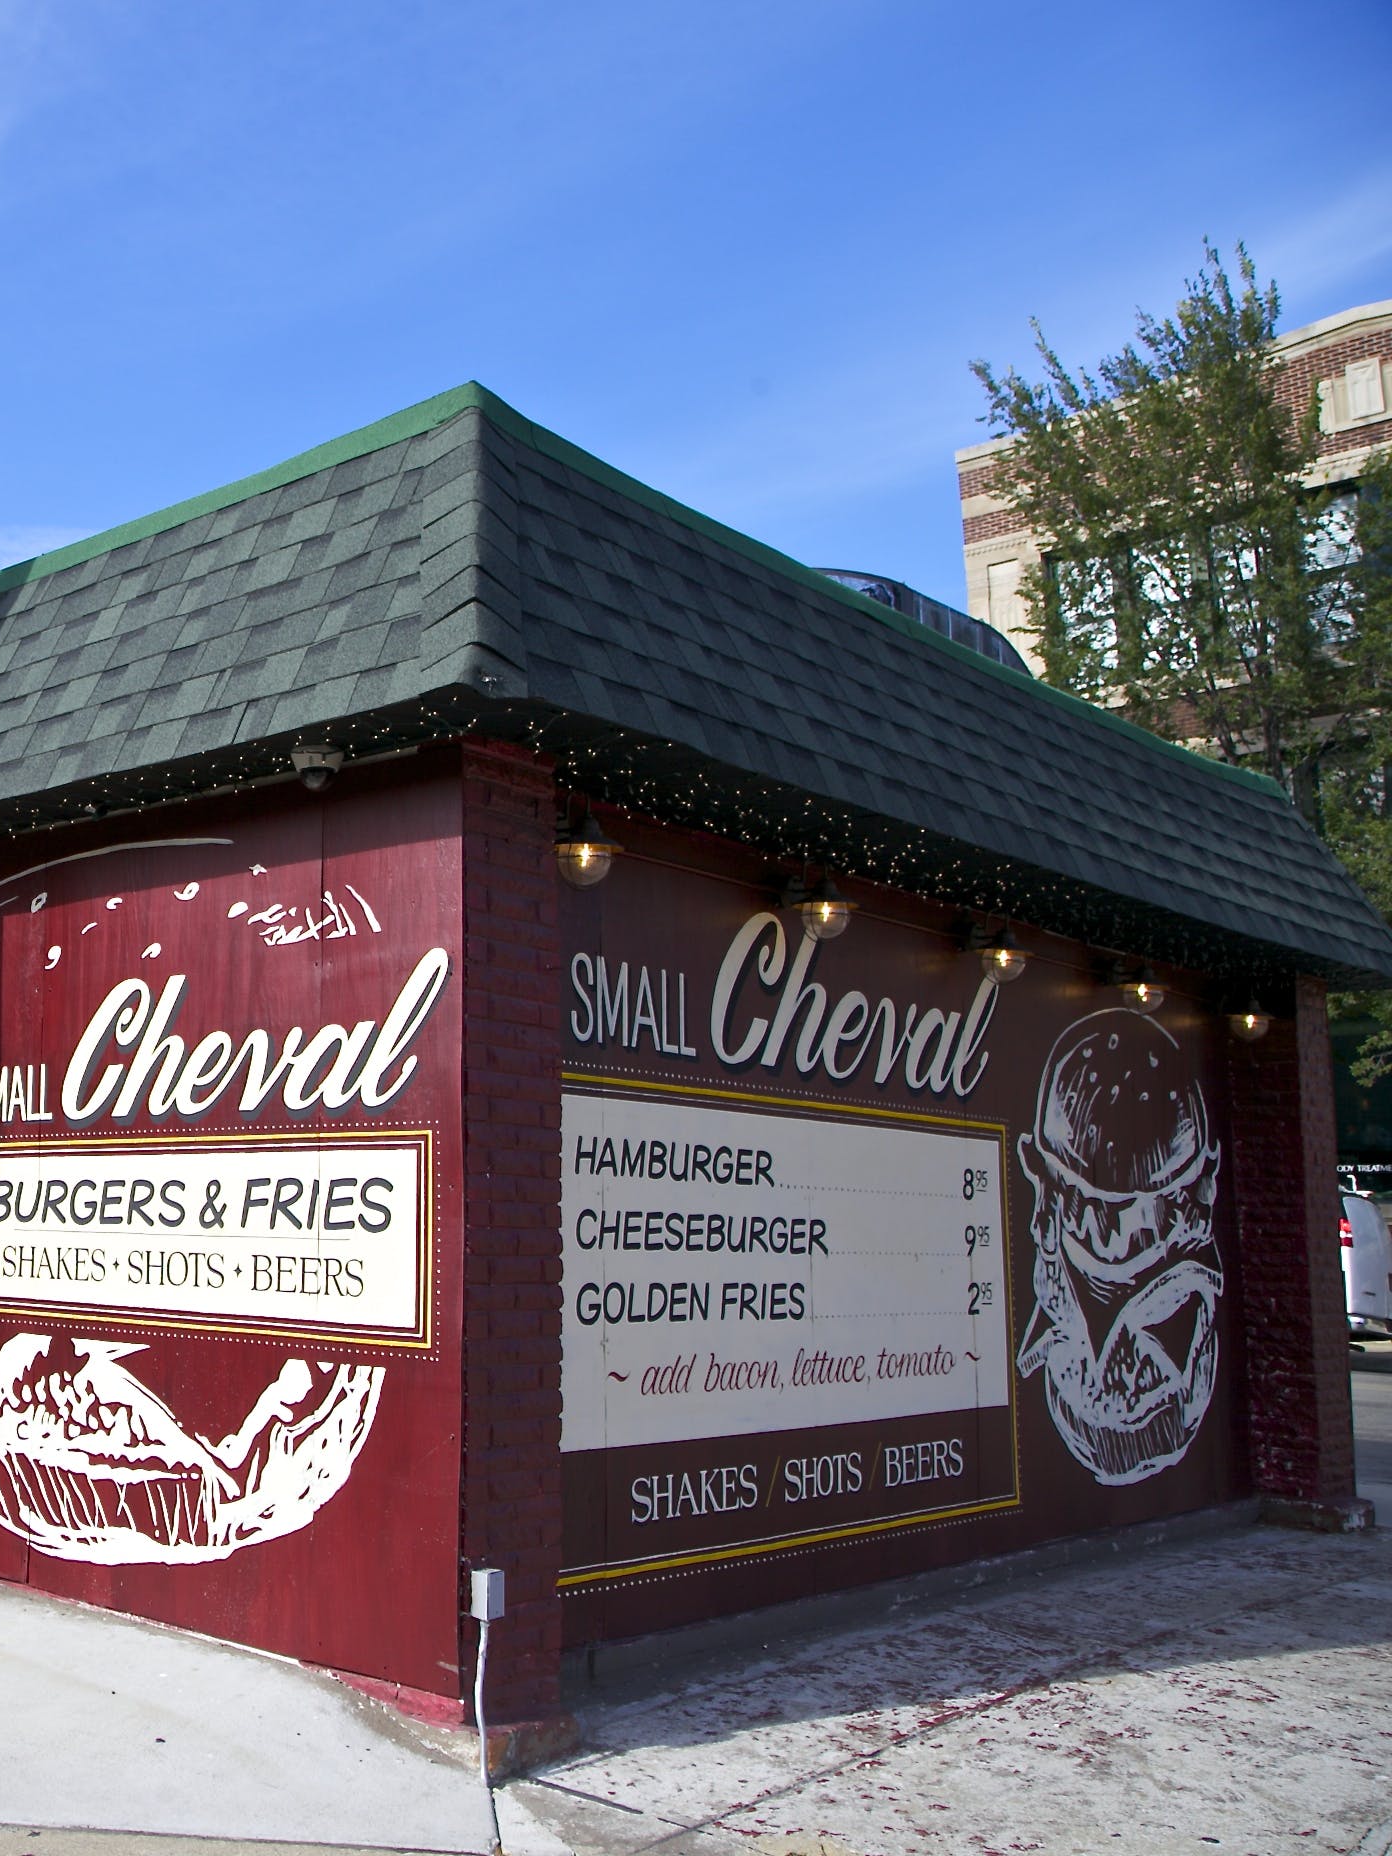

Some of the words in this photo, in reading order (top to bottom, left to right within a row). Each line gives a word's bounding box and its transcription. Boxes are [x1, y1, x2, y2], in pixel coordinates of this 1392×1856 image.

[570, 952, 696, 1057] SMALL
[710, 912, 999, 1097] Cheval
[61, 947, 450, 1125] Cheval
[574, 1136, 775, 1187] HAMBURGER
[199, 1179, 228, 1230] &
[240, 1177, 395, 1233] FRIES
[575, 1209, 829, 1257] CHEESEBURGER
[2, 1245, 106, 1282] SHAKES
[127, 1250, 225, 1289] SHOTS
[250, 1253, 365, 1297] BEERS
[576, 1282, 710, 1326] GOLDEN
[720, 1283, 806, 1321] FRIES
[640, 1353, 697, 1396] add
[704, 1353, 785, 1395] bacon,
[790, 1347, 871, 1388] lettuce,
[876, 1344, 956, 1379] tomato
[630, 1464, 758, 1524] SHAKES
[783, 1451, 862, 1502] SHOTS
[884, 1438, 964, 1488] BEERS
